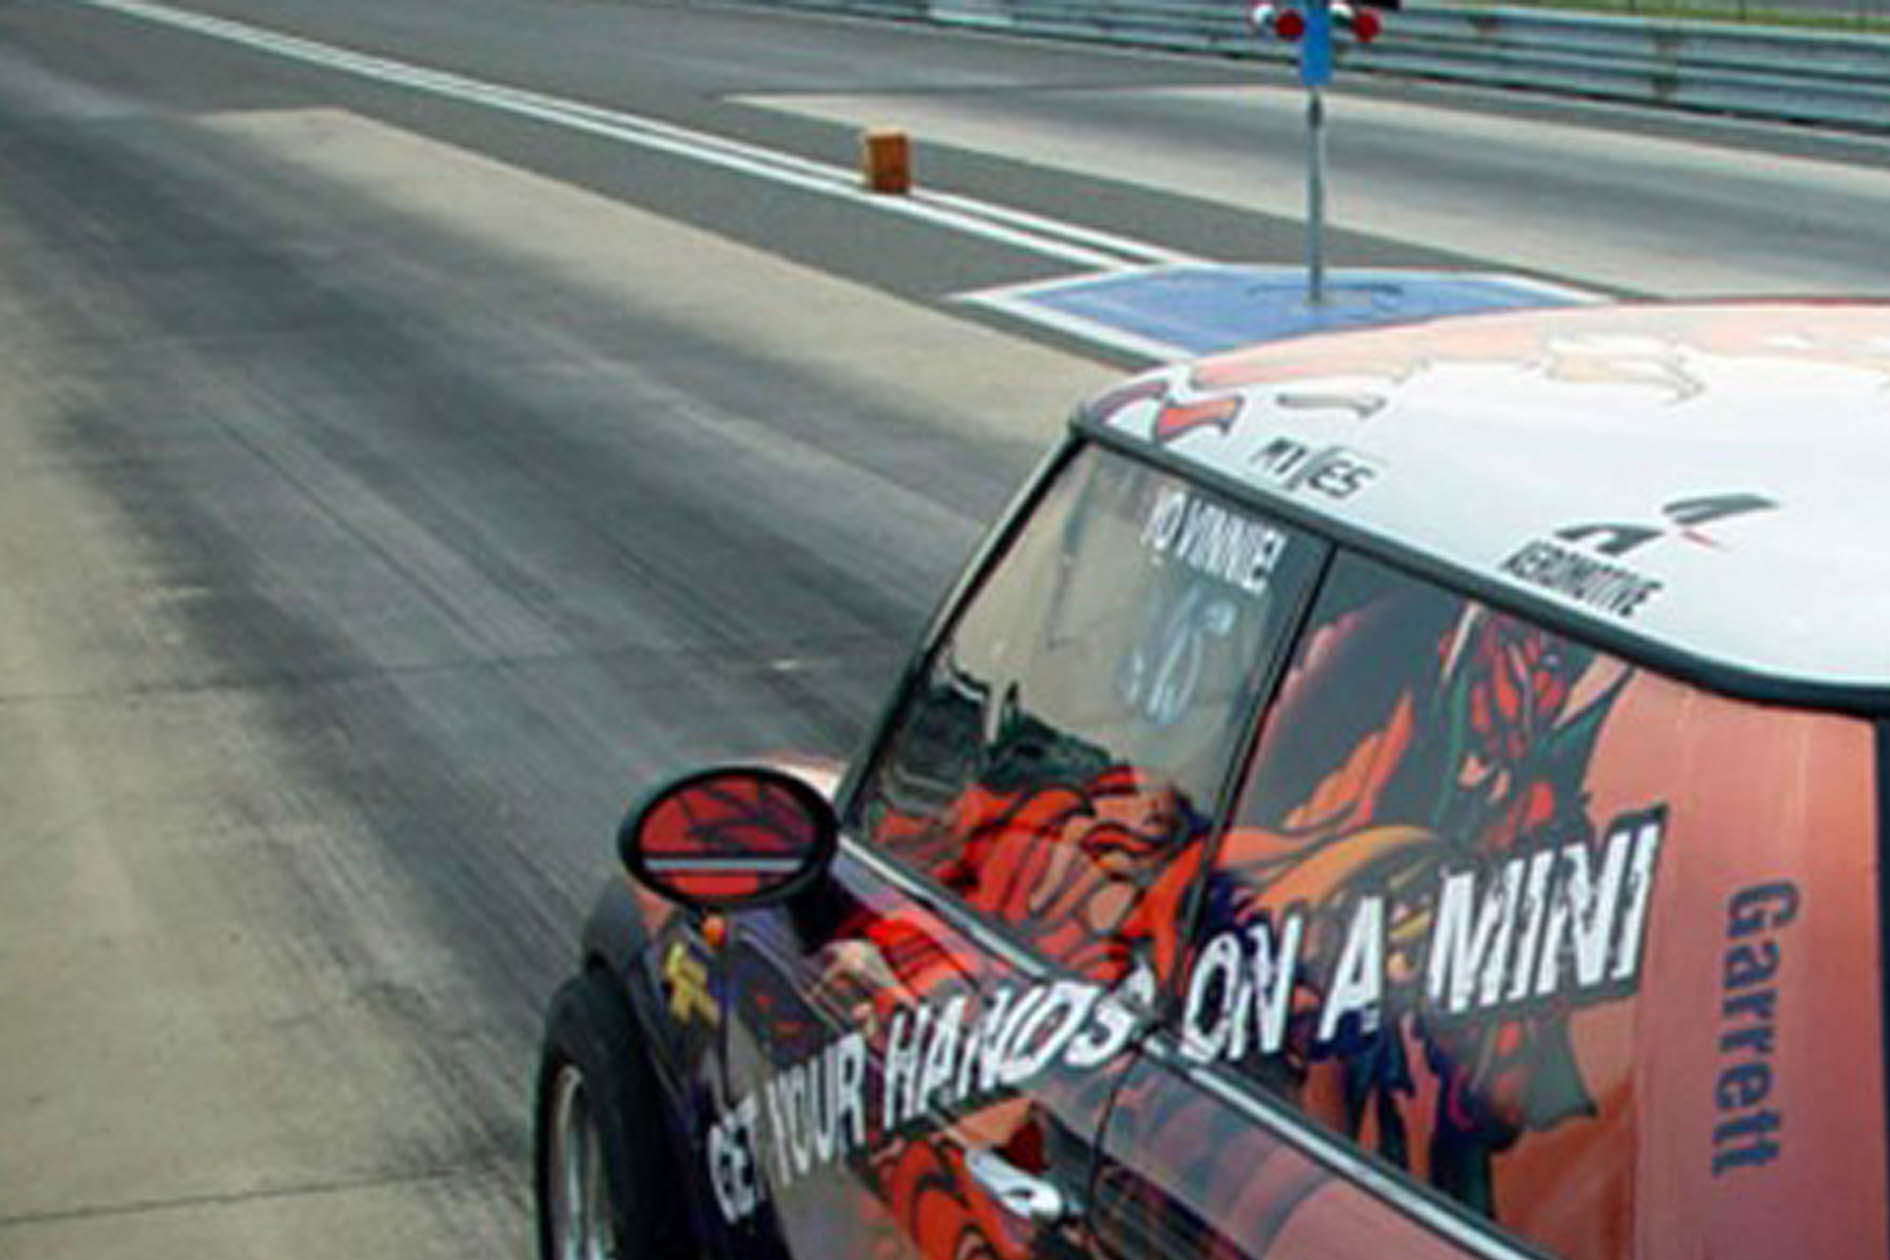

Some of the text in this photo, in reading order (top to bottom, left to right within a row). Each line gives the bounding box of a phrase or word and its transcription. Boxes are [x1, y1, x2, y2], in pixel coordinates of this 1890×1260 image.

[767, 1031, 867, 1188] YOUR
[1180, 914, 1300, 1063] ON
[1317, 896, 1385, 1041] A
[1427, 824, 1659, 1014] MINI
[1711, 879, 1800, 1178] Garrett
